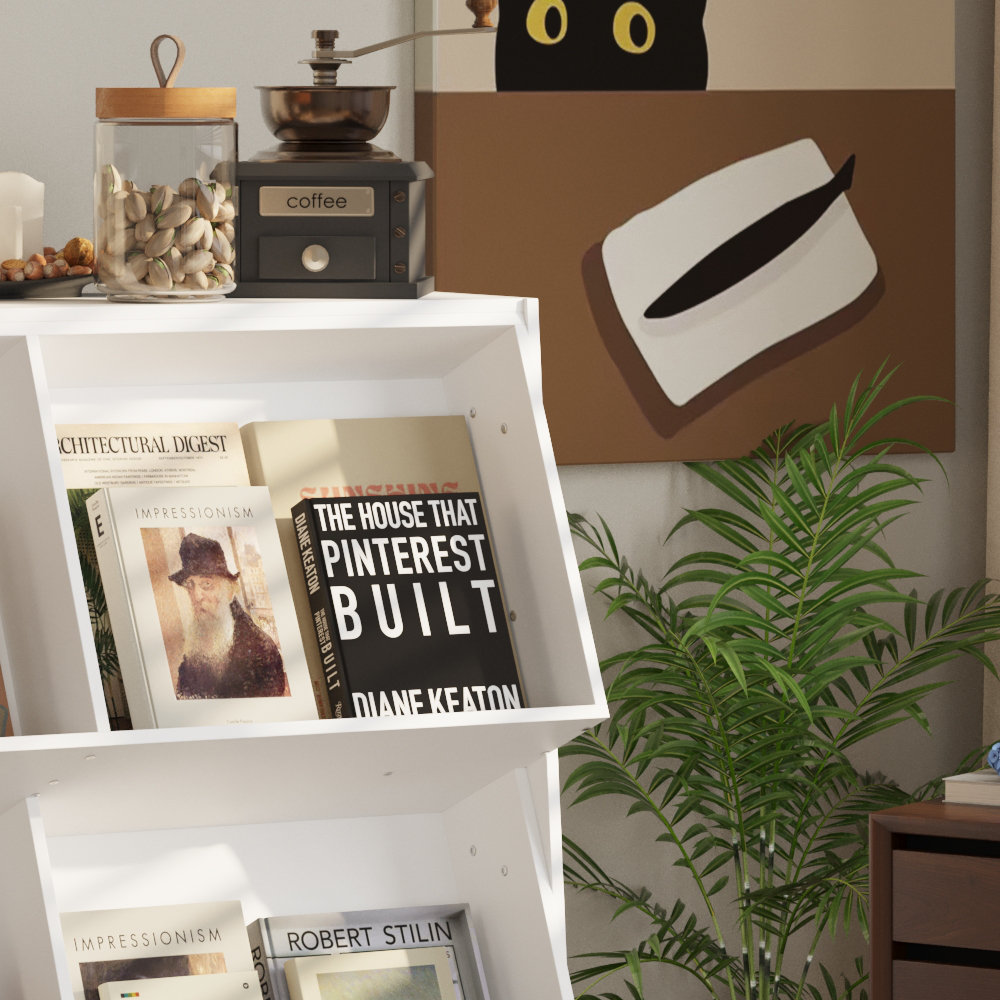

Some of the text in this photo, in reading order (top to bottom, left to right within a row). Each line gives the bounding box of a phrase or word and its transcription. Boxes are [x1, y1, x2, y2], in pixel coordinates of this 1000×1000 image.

[287, 193, 347, 209] coffee
[173, 435, 227, 453] DIGEST
[135, 507, 254, 519] IMPRESSIONISM
[313, 498, 478, 532] THE HOUSE THAT
[294, 512, 320, 596] DIANE KEATON
[320, 534, 487, 578] PINTEREST
[330, 579, 497, 641] BUILT
[321, 641, 340, 691] BUILT
[352, 688, 423, 718] DIANE
[428, 684, 521, 714] KEATON
[73, 927, 223, 952] IMPRESSIONISM
[287, 920, 453, 951] ROBERT STILIN
